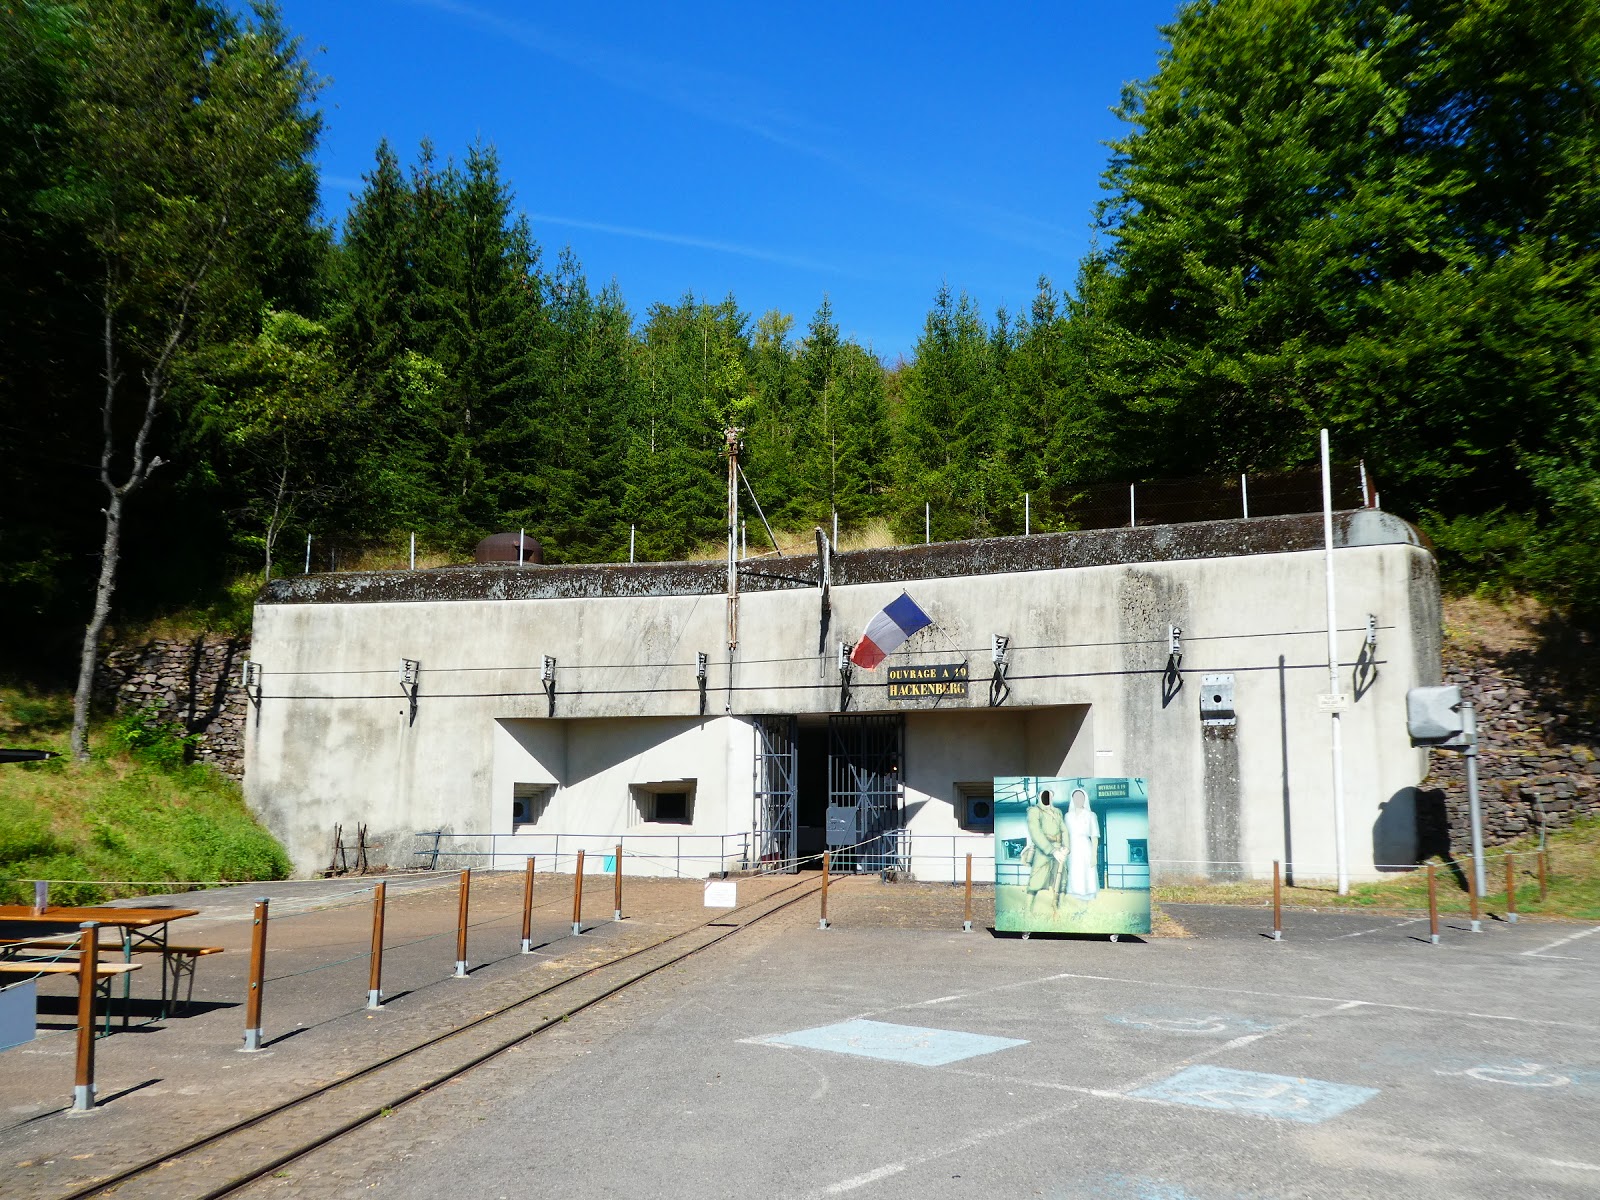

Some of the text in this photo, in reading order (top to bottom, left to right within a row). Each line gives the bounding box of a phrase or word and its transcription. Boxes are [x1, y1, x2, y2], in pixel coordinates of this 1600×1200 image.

[889, 669, 937, 679] OUVRAGE
[942, 668, 949, 678] A
[889, 683, 965, 697] HACKENBERG
